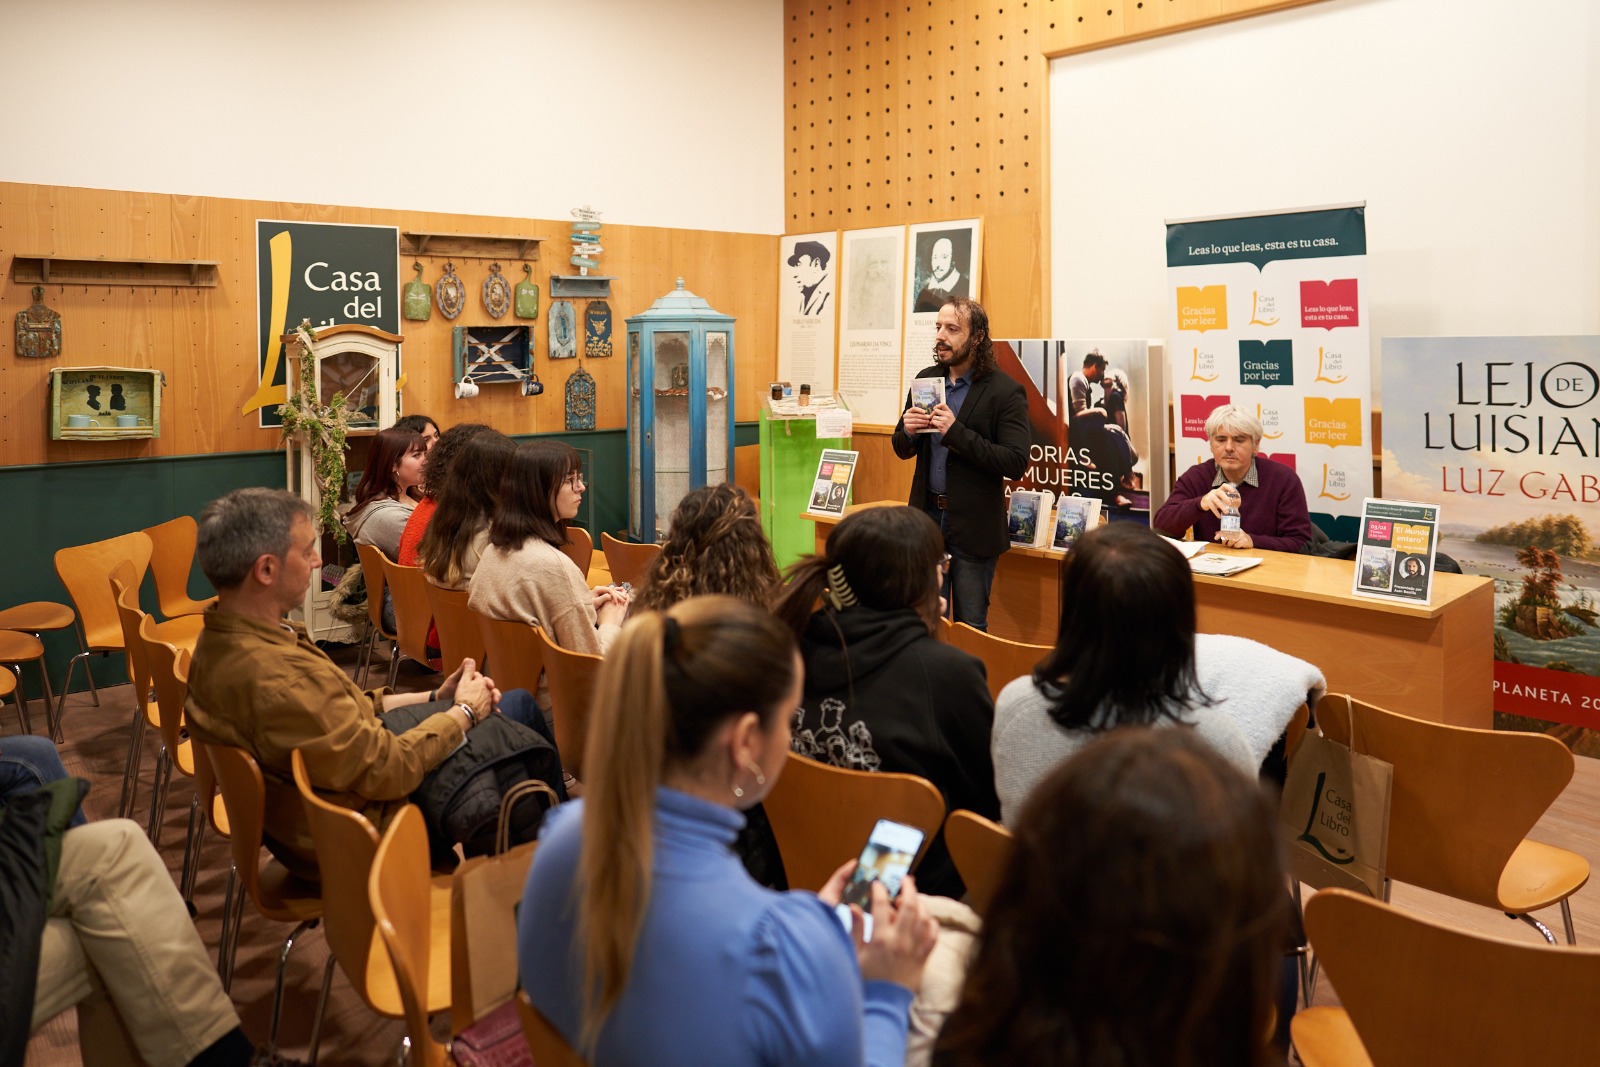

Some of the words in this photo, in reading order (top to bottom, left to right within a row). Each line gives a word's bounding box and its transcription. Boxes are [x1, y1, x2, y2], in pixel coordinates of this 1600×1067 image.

[1188, 246, 1210, 256] Leas
[1212, 244, 1220, 254] lo
[1222, 245, 1240, 256] que
[1241, 242, 1264, 252] leas,
[1264, 241, 1286, 250] esta
[1286, 240, 1298, 248] es
[1300, 238, 1312, 248] tu
[1312, 237, 1339, 246] casa.
[304, 262, 382, 292] Casa
[343, 296, 382, 318] del
[1182, 306, 1216, 316] Gracias
[1183, 318, 1198, 328] por
[1199, 316, 1217, 326] leer
[1243, 360, 1280, 370] Gracias
[1244, 372, 1260, 382] por
[1261, 370, 1280, 380] leer
[1556, 378, 1584, 392] DE
[1309, 418, 1346, 429] Gracias
[1310, 431, 1326, 440] por
[1328, 430, 1348, 440] leer
[1021, 466, 1114, 491] MUJERES
[1329, 469, 1345, 477] Casa
[1442, 466, 1506, 496] LUZ
[1519, 471, 1600, 503] GAB
[1404, 527, 1429, 536] Mundo
[1493, 680, 1572, 705] PLANETA
[1326, 789, 1352, 812] Casa
[1320, 811, 1349, 837] Libro
[1336, 810, 1351, 825] del
